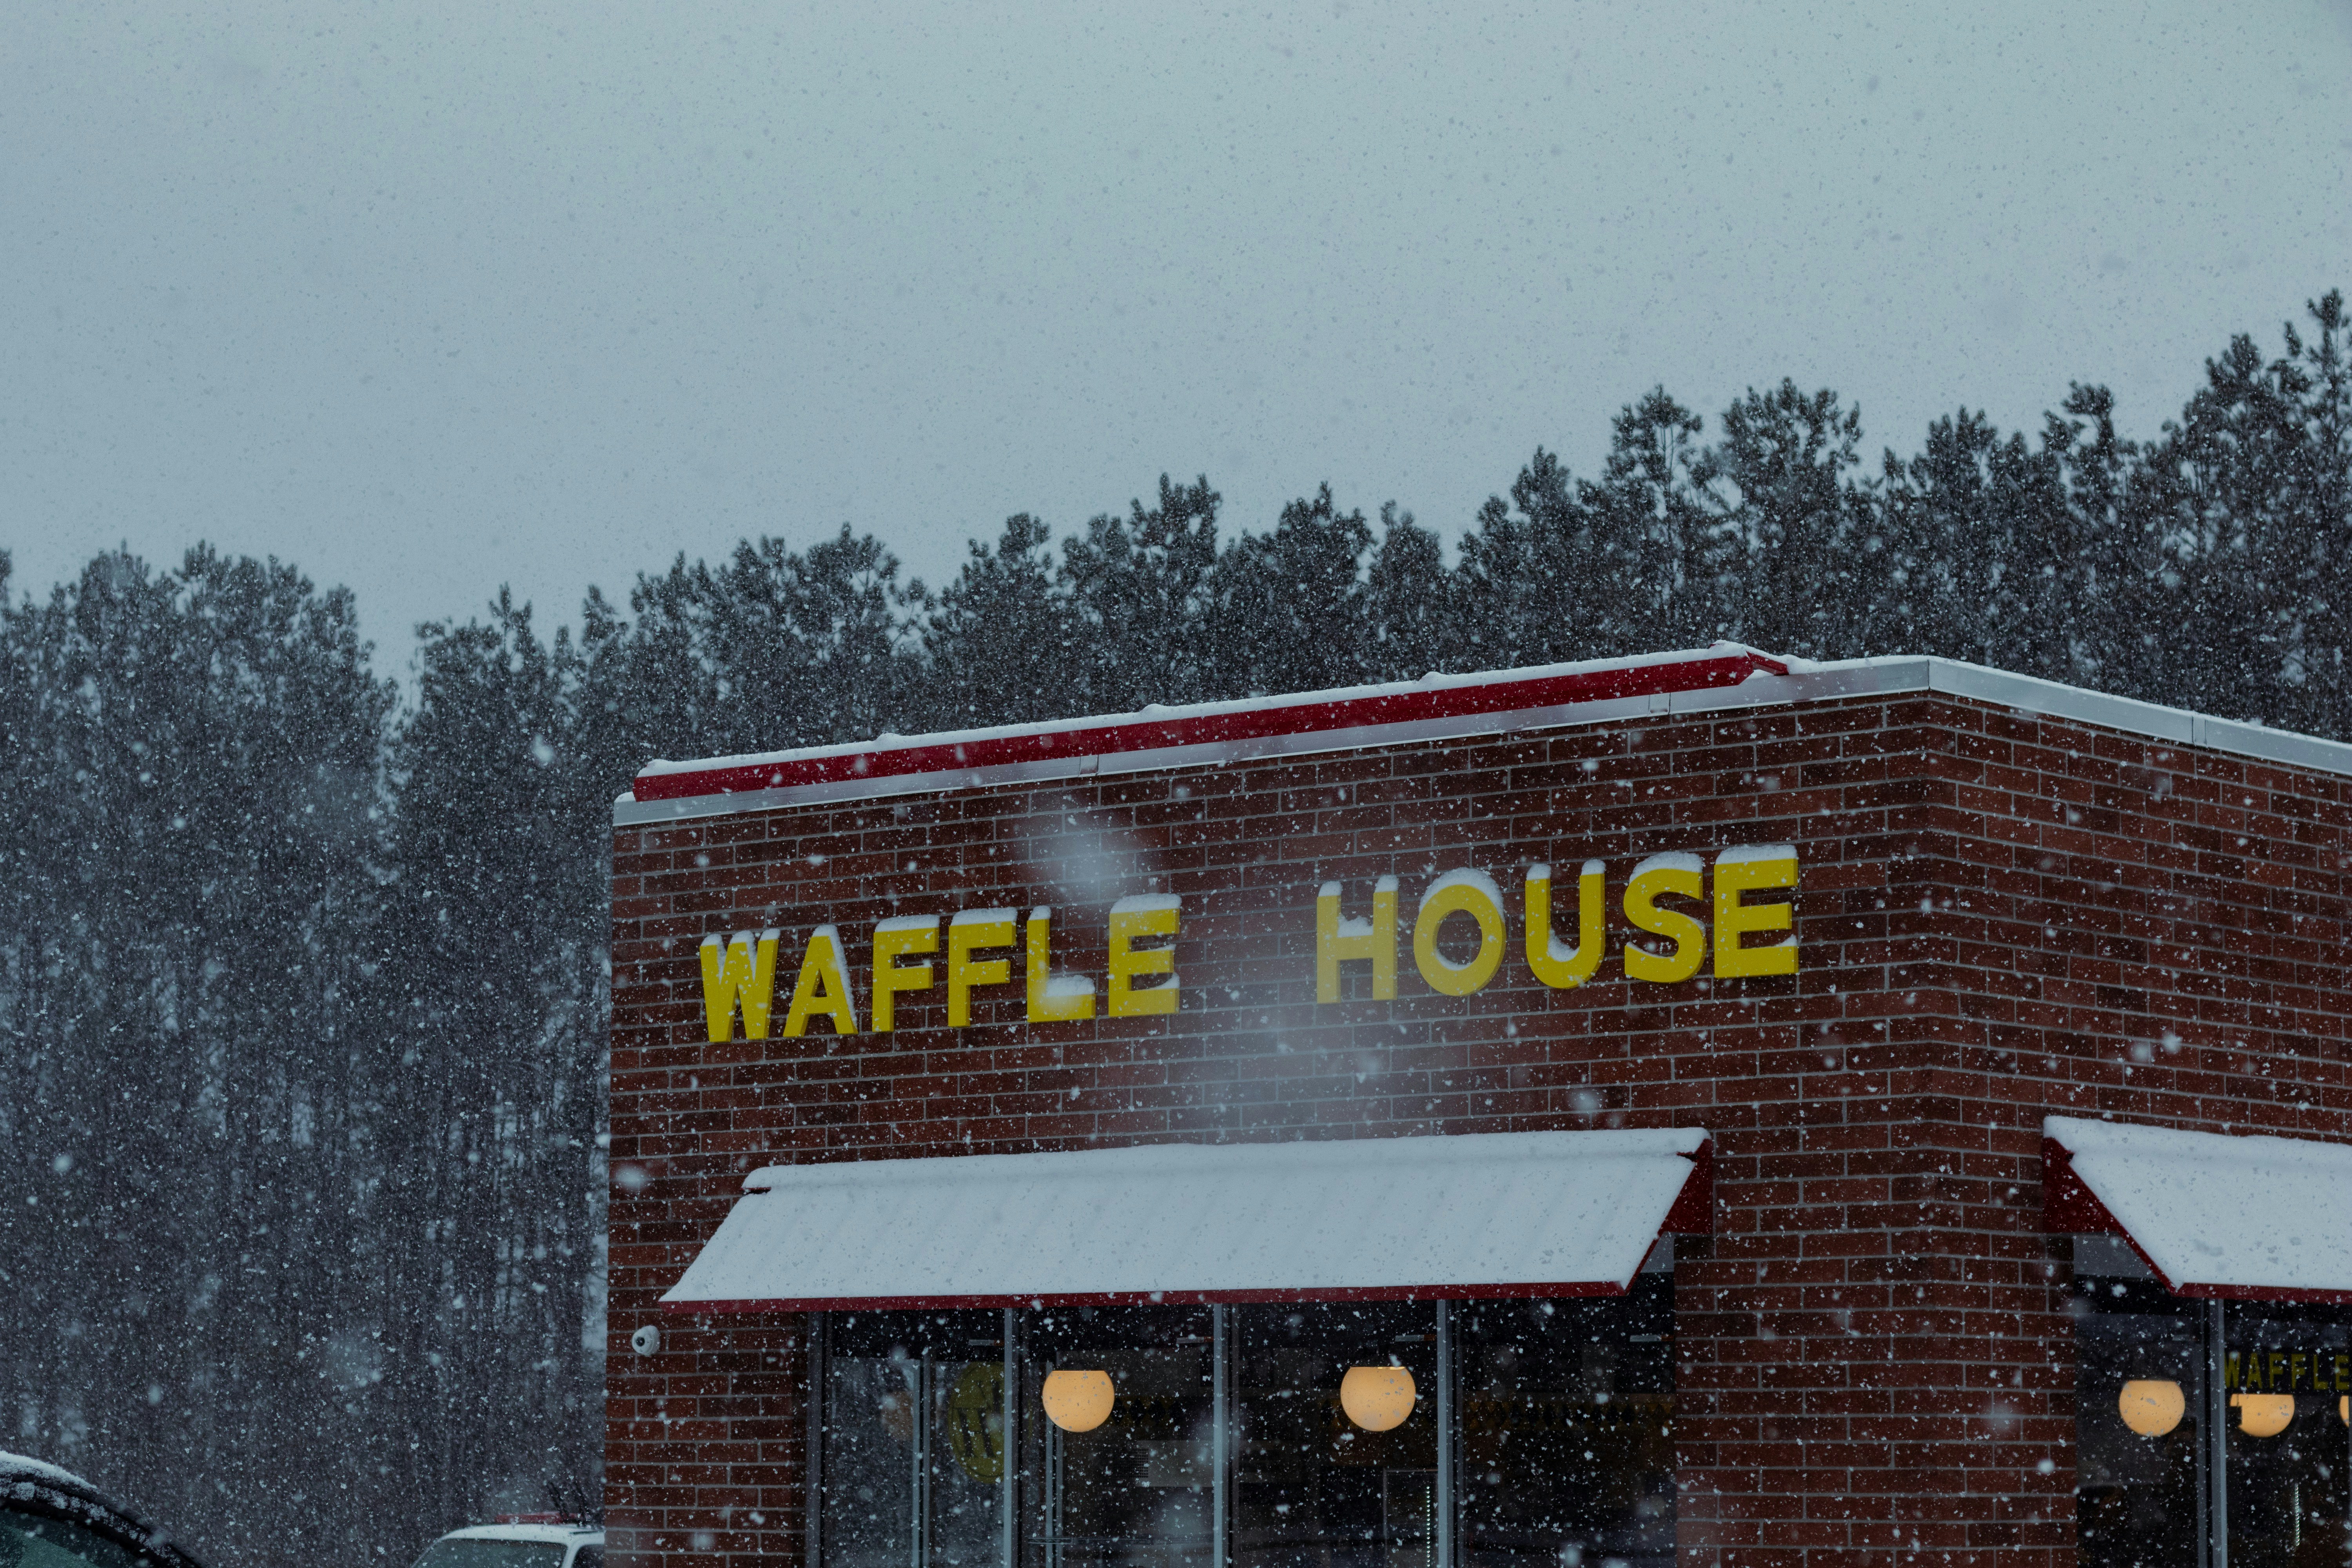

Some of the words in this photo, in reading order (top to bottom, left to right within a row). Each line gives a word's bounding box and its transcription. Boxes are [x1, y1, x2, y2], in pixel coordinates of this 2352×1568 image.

[700, 905, 1180, 1043] WAFFLE
[1317, 855, 1799, 1004] HOUSE
[2225, 1352, 2349, 1390] WAFFLE
